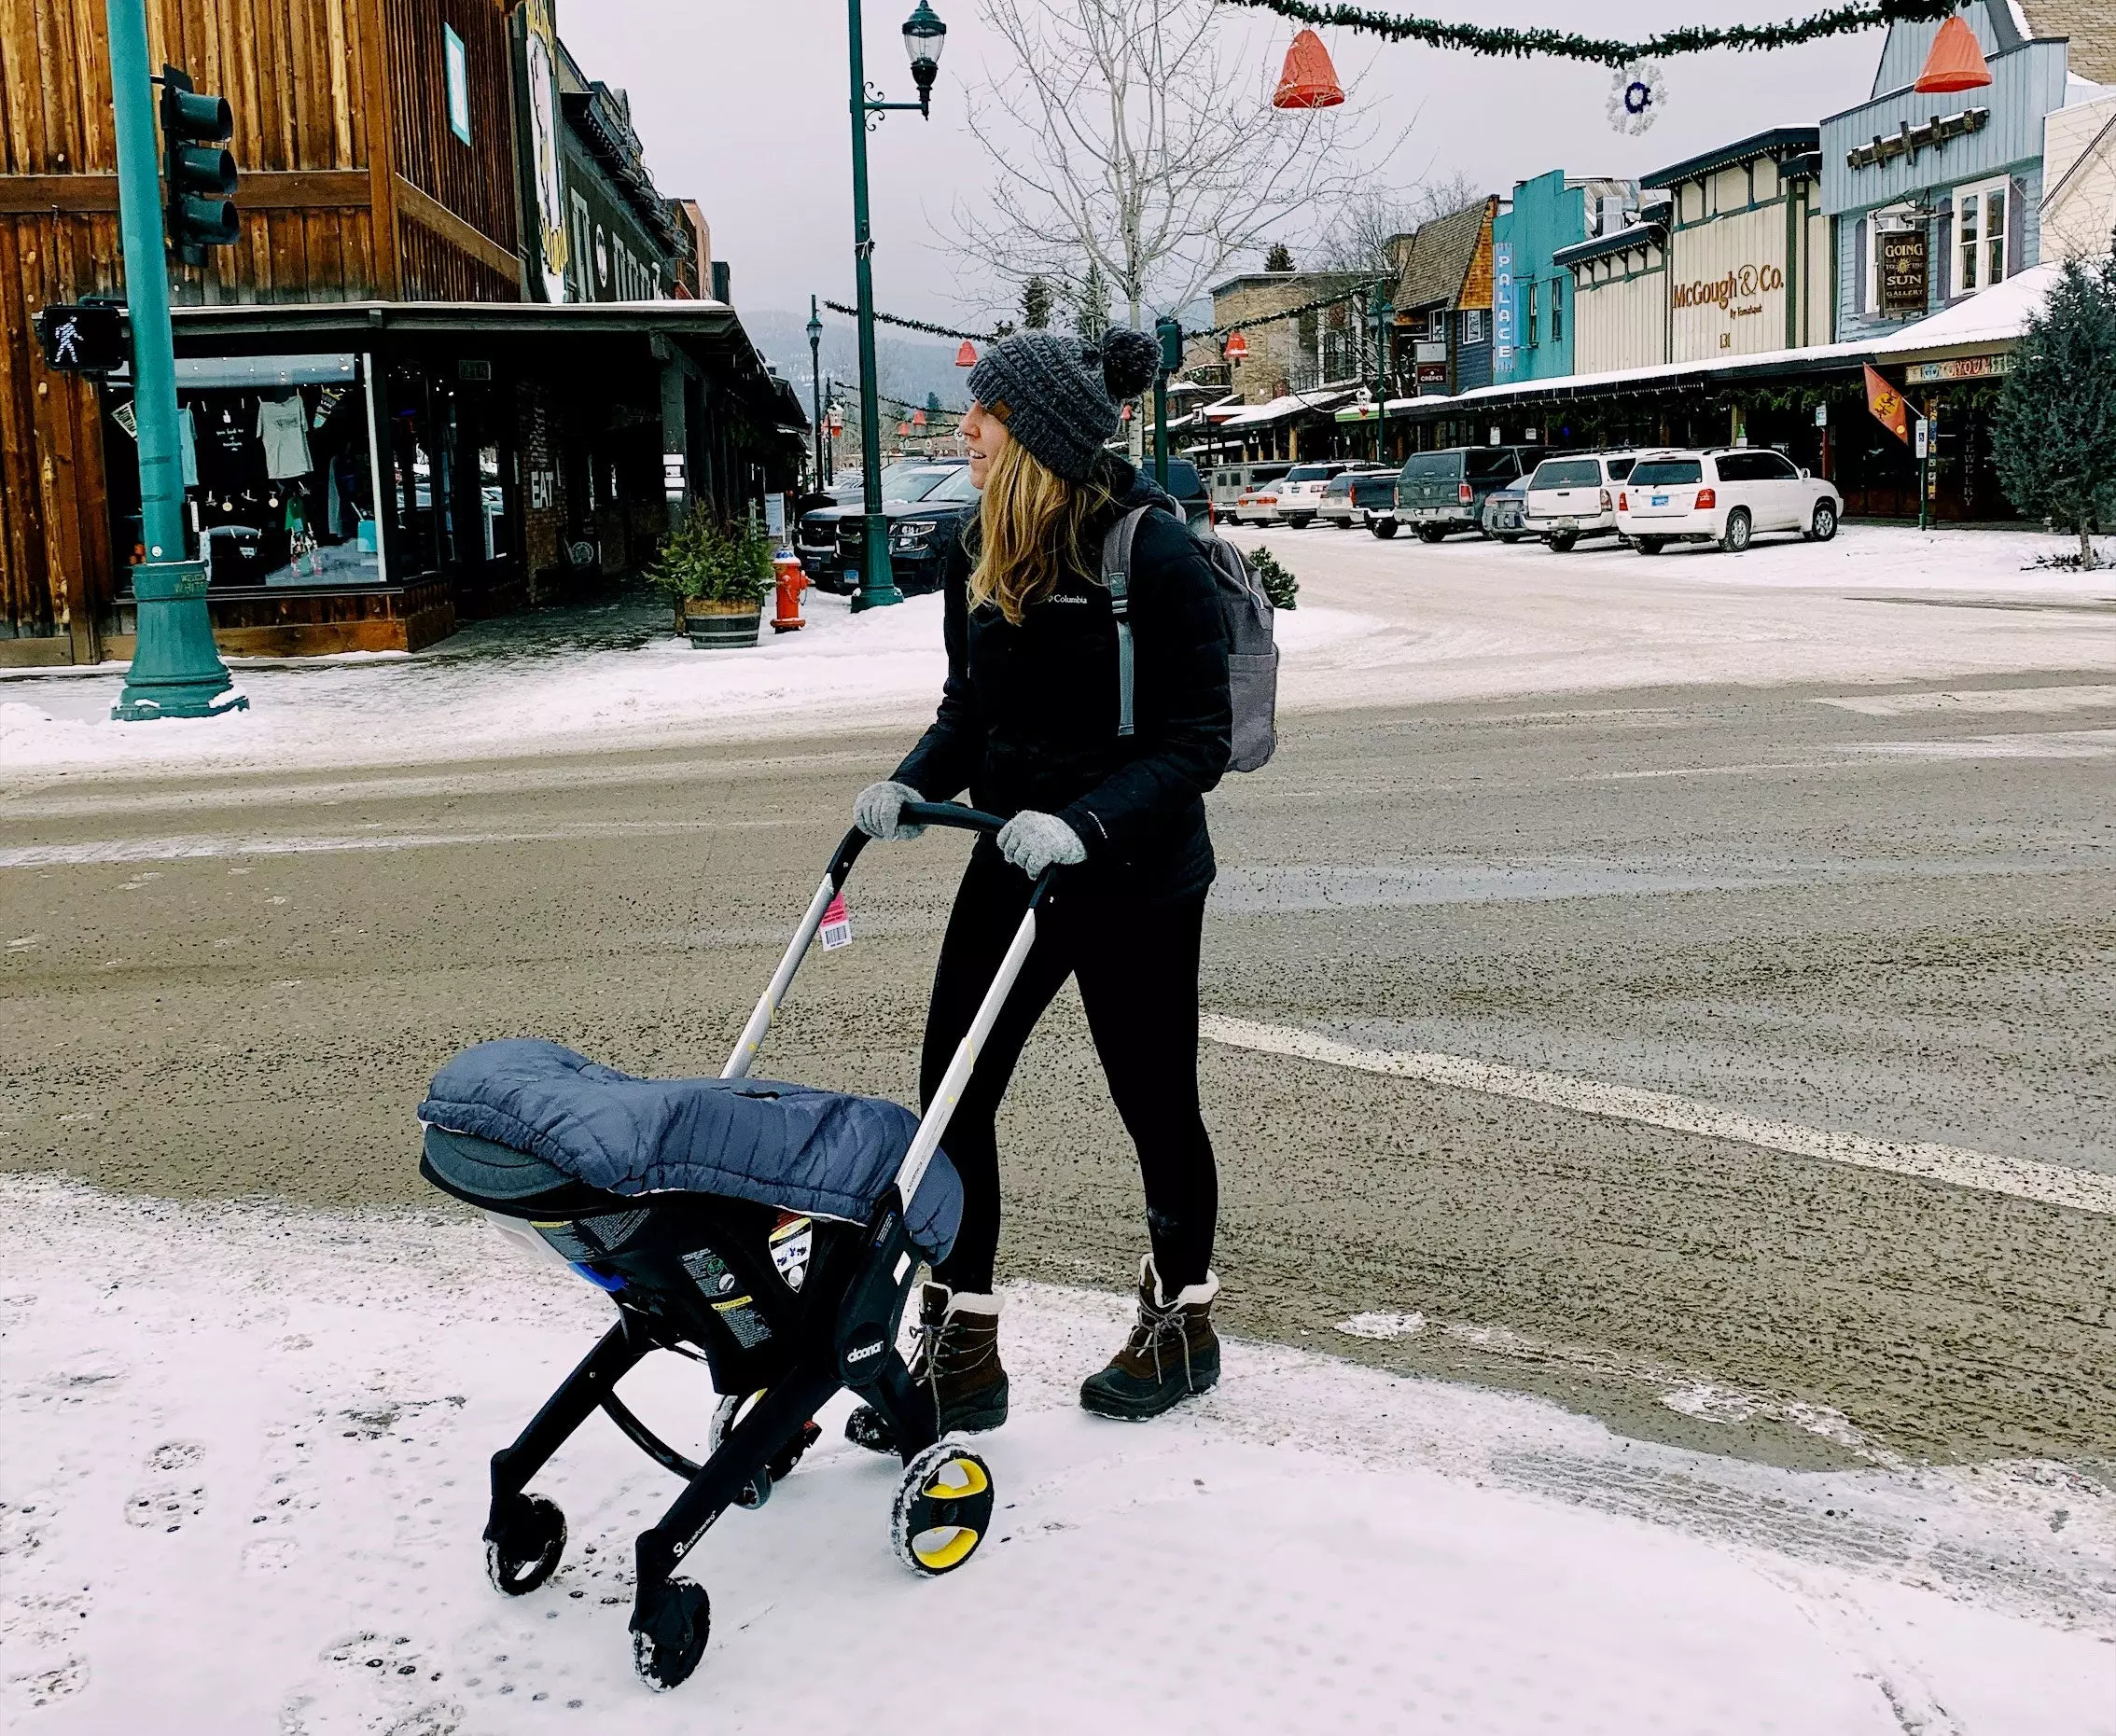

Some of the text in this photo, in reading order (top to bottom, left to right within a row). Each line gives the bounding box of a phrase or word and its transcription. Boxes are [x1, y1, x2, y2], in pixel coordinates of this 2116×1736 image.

[1885, 243, 1924, 257] GOING
[1672, 264, 1785, 311] McGough & Co.
[1886, 274, 1922, 286] SUN
[1886, 289, 1924, 298] GALLERY
[1497, 255, 1511, 358] PALACE
[1719, 332, 1732, 349] 131
[1963, 433, 1976, 507] JEWELRY
[531, 469, 554, 508] EAT
[1053, 593, 1088, 604] Columbia
[846, 1341, 882, 1364] doona
